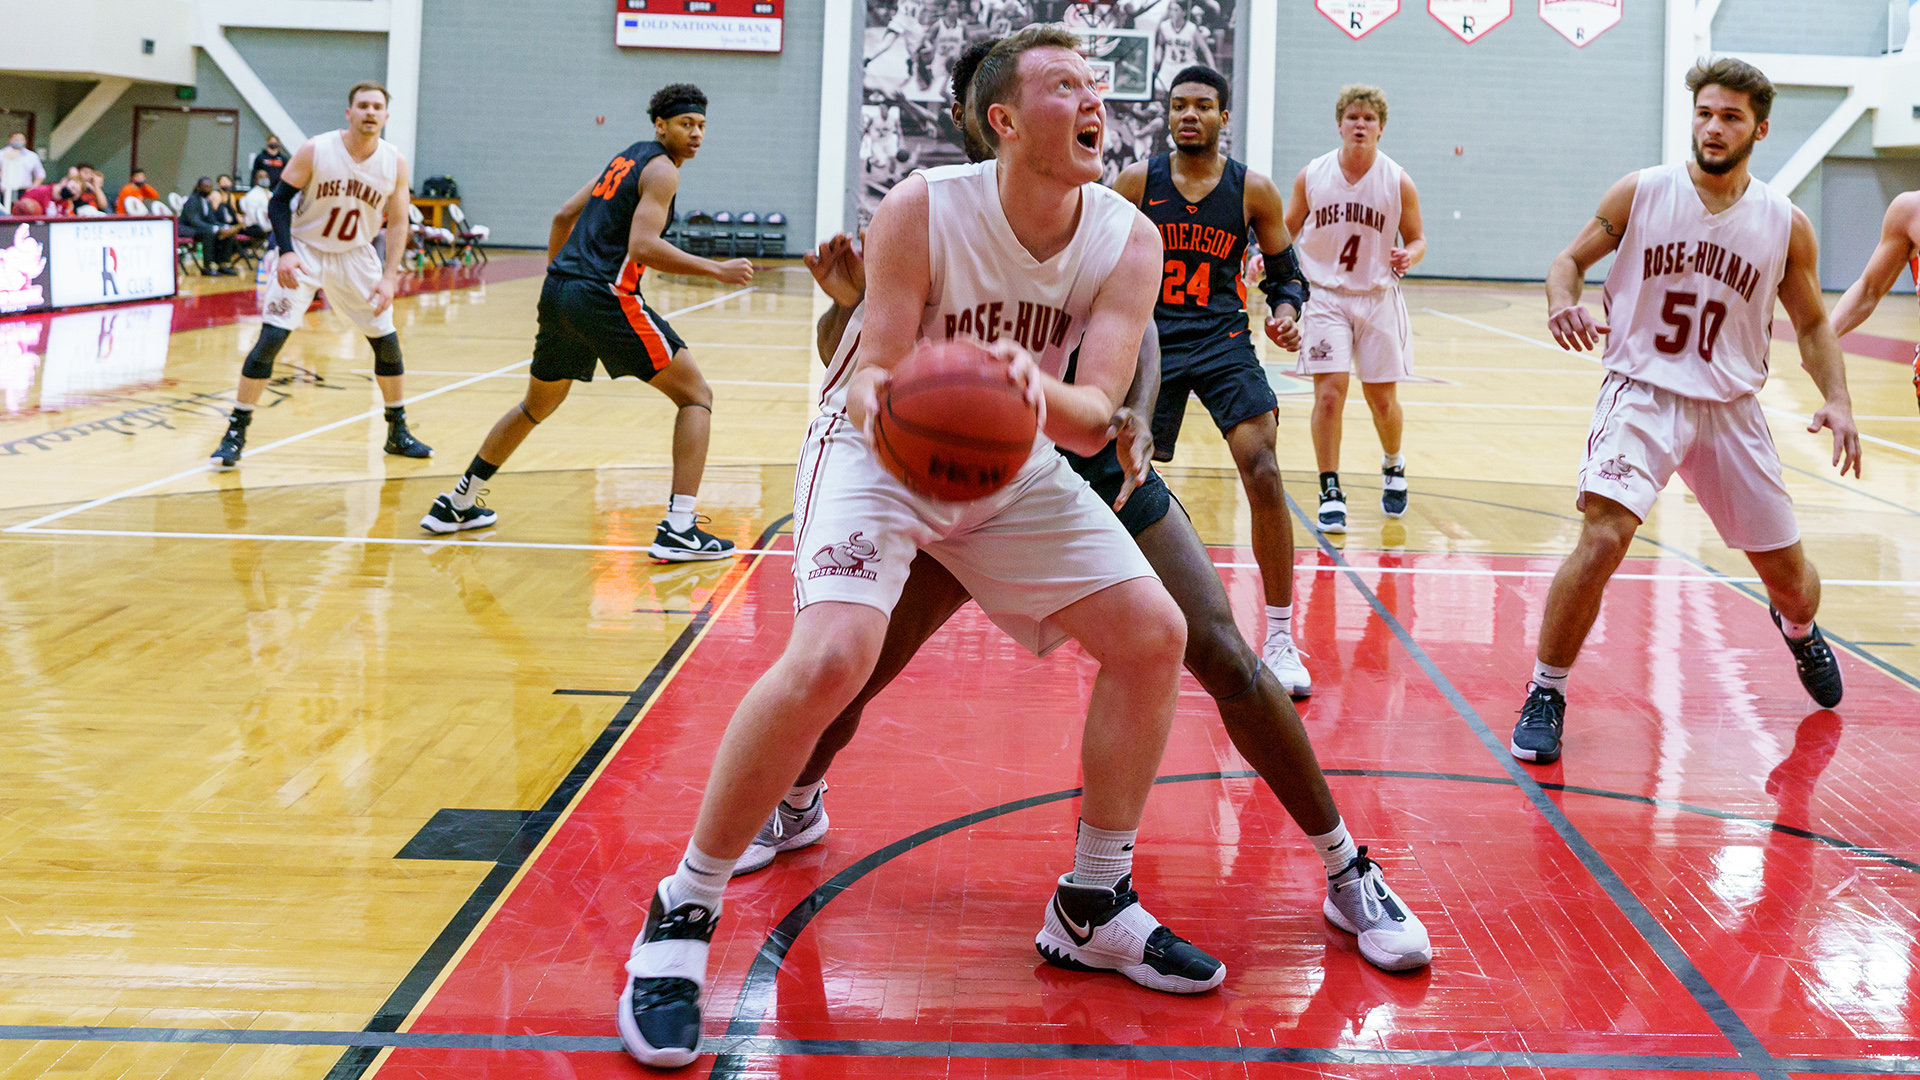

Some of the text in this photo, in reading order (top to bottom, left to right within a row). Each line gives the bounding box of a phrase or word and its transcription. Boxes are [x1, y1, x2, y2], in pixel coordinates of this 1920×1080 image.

[642, 19, 772, 33] OLD NATIONAL BANK
[1350, 12, 1363, 29] R
[1463, 15, 1476, 34] R
[1576, 27, 1585, 40] R
[591, 155, 636, 200] 33
[322, 206, 360, 241] 10
[1315, 202, 1385, 233] ROSE-HULMAN
[1339, 234, 1361, 272] 4
[128, 277, 153, 295] CLUB
[1163, 259, 1211, 306] 24
[1643, 240, 1761, 303] ROSE-HULMAN
[1655, 290, 1727, 363] 50
[808, 567, 878, 581] ROSE-HULMAN
